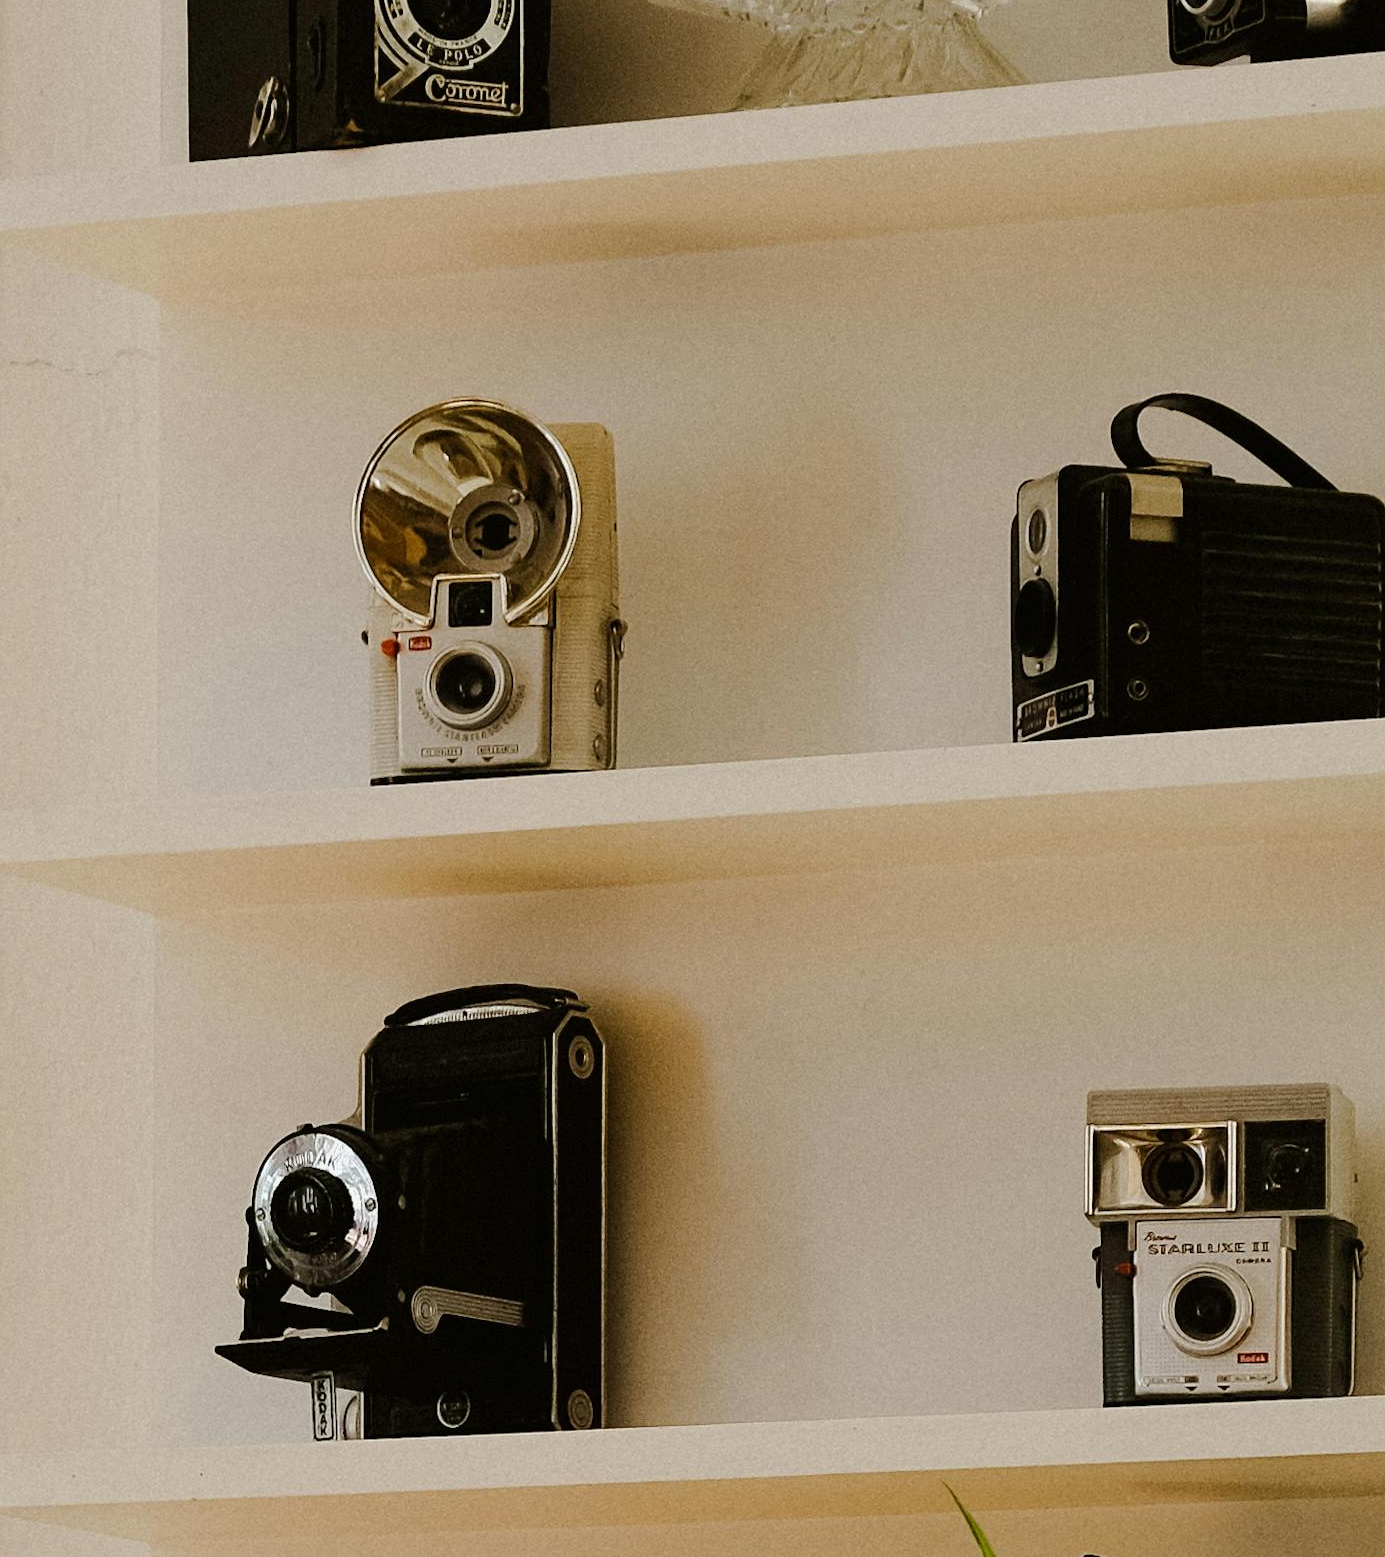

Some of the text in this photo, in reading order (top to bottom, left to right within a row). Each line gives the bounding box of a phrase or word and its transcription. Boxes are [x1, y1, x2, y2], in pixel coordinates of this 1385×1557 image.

[444, 44, 482, 61] POLO
[425, 74, 508, 108] Coronet
[1147, 1242, 1246, 1255] STARLUXE
[317, 1379, 327, 1436] KODAK
